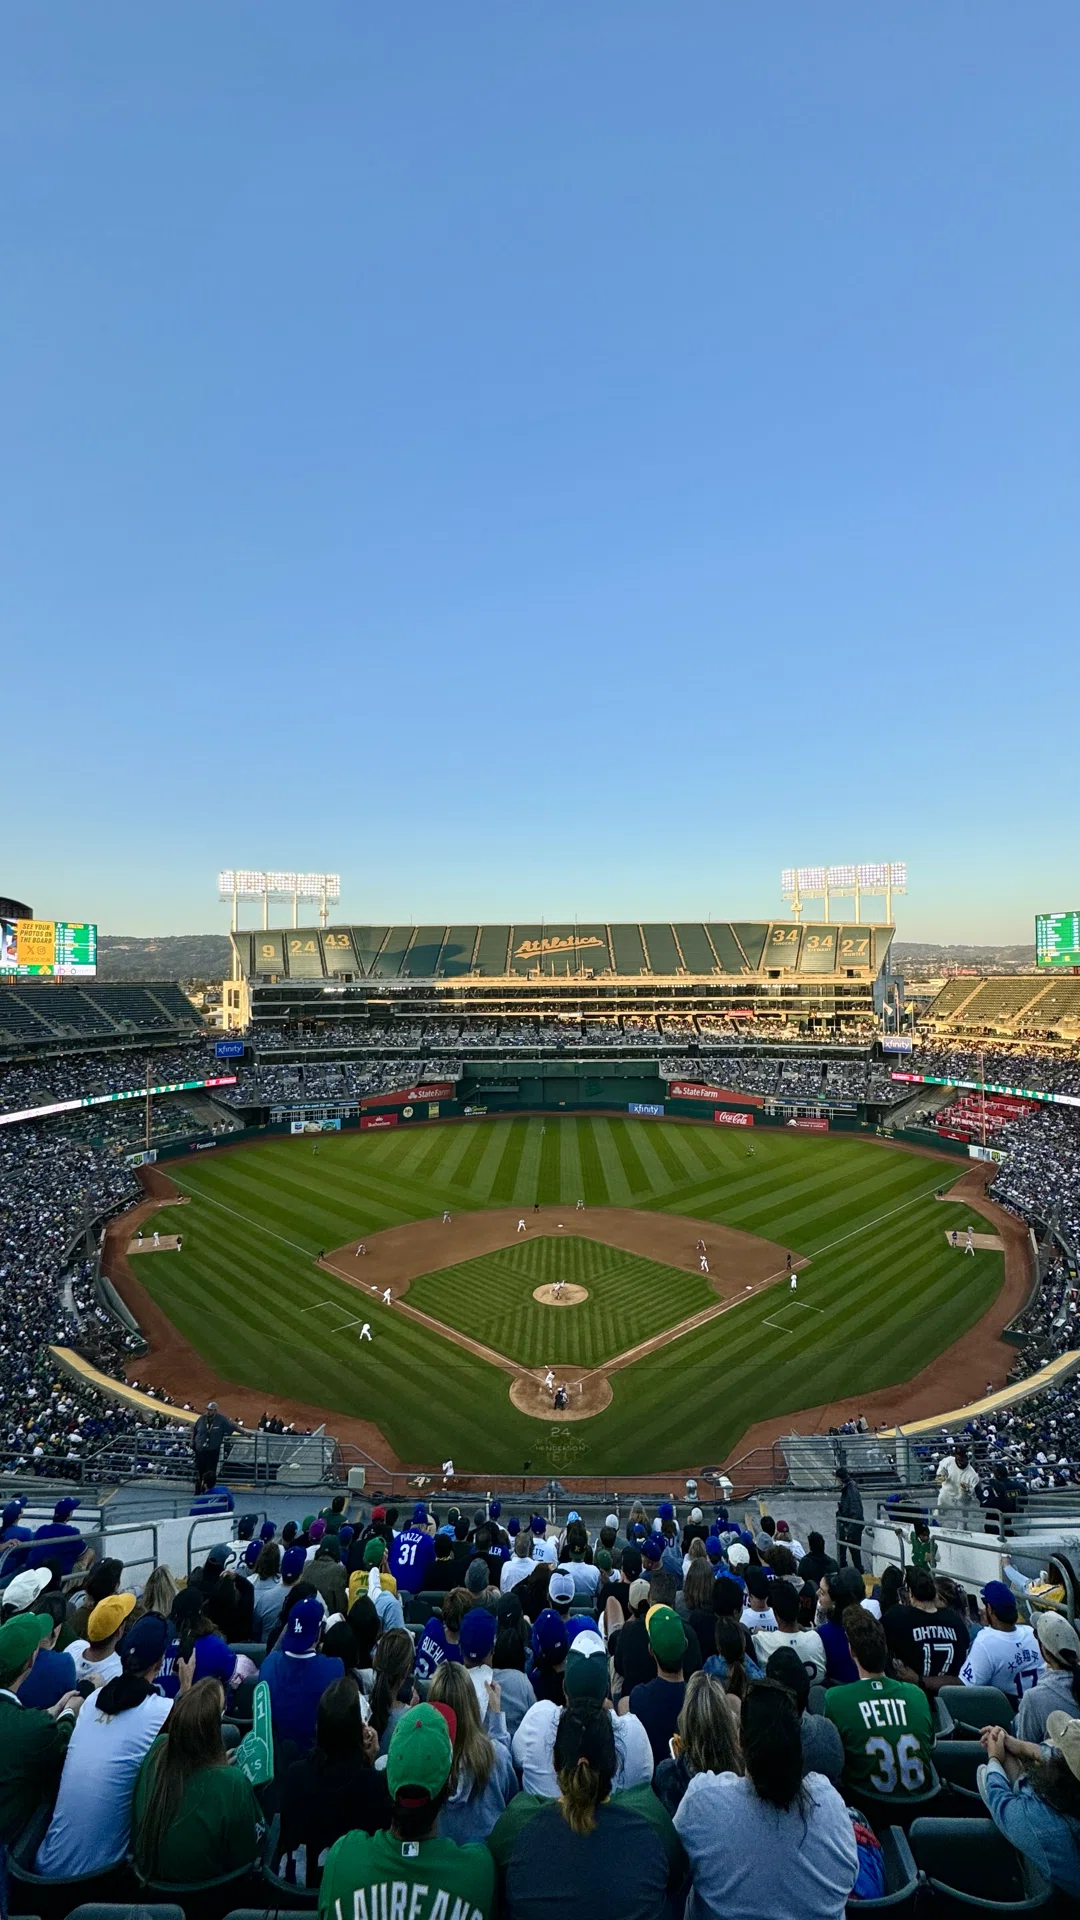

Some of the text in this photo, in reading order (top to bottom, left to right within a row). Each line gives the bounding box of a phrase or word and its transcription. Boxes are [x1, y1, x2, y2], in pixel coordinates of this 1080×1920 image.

[325, 934, 350, 946] 43
[773, 929, 799, 942] 34
[807, 935, 833, 948] 34
[262, 945, 275, 958] 9
[290, 940, 317, 953] 24
[514, 935, 604, 959] Athletics
[842, 938, 870, 952] 27
[218, 1045, 242, 1055] xfinity
[885, 1040, 910, 1050] xfinity
[634, 1105, 659, 1115] xfinity
[551, 1427, 571, 1437] 24
[400, 1532, 423, 1544] PIAZZA
[398, 1543, 418, 1566] 31
[294, 1618, 303, 1633] LA
[913, 1625, 958, 1642] OHTANI
[922, 1642, 955, 1677] 17
[1013, 1668, 1040, 1700] 17
[858, 1698, 908, 1730] PETIT
[865, 1733, 926, 1793] 36
